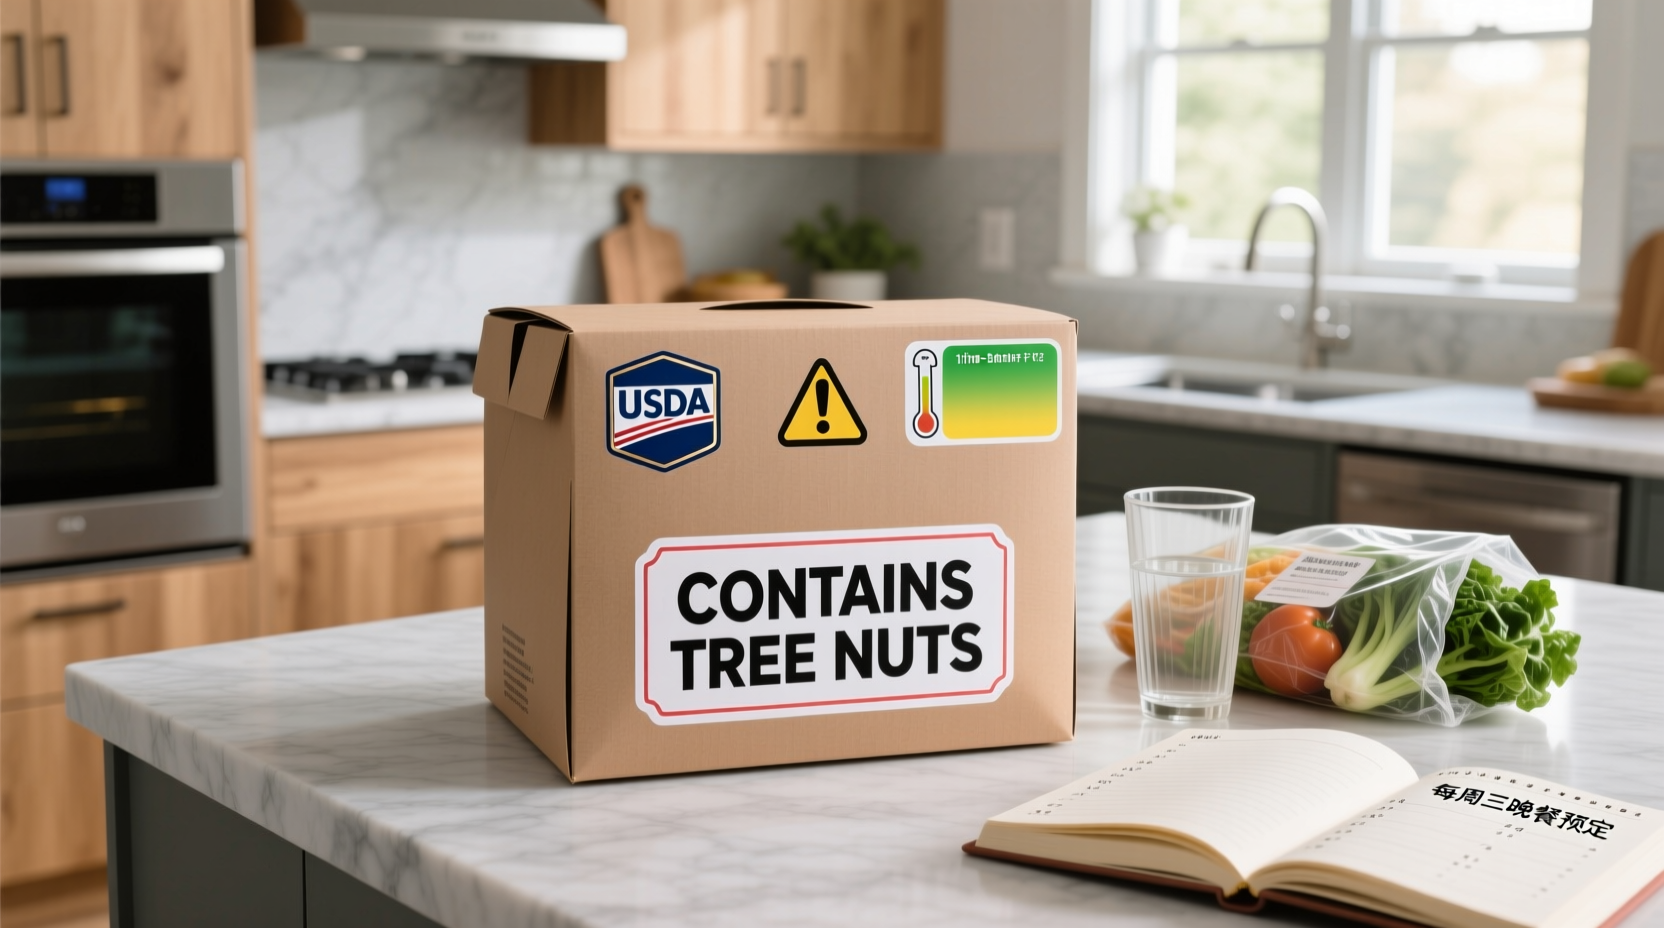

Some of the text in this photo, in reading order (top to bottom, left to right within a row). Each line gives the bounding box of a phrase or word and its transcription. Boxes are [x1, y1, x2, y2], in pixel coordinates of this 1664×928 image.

[618, 387, 710, 419] USDA
[677, 559, 974, 625] CONTAINS
[670, 622, 983, 691] TREE NUTS
[1431, 783, 1615, 840] 每周三晚餐预定
